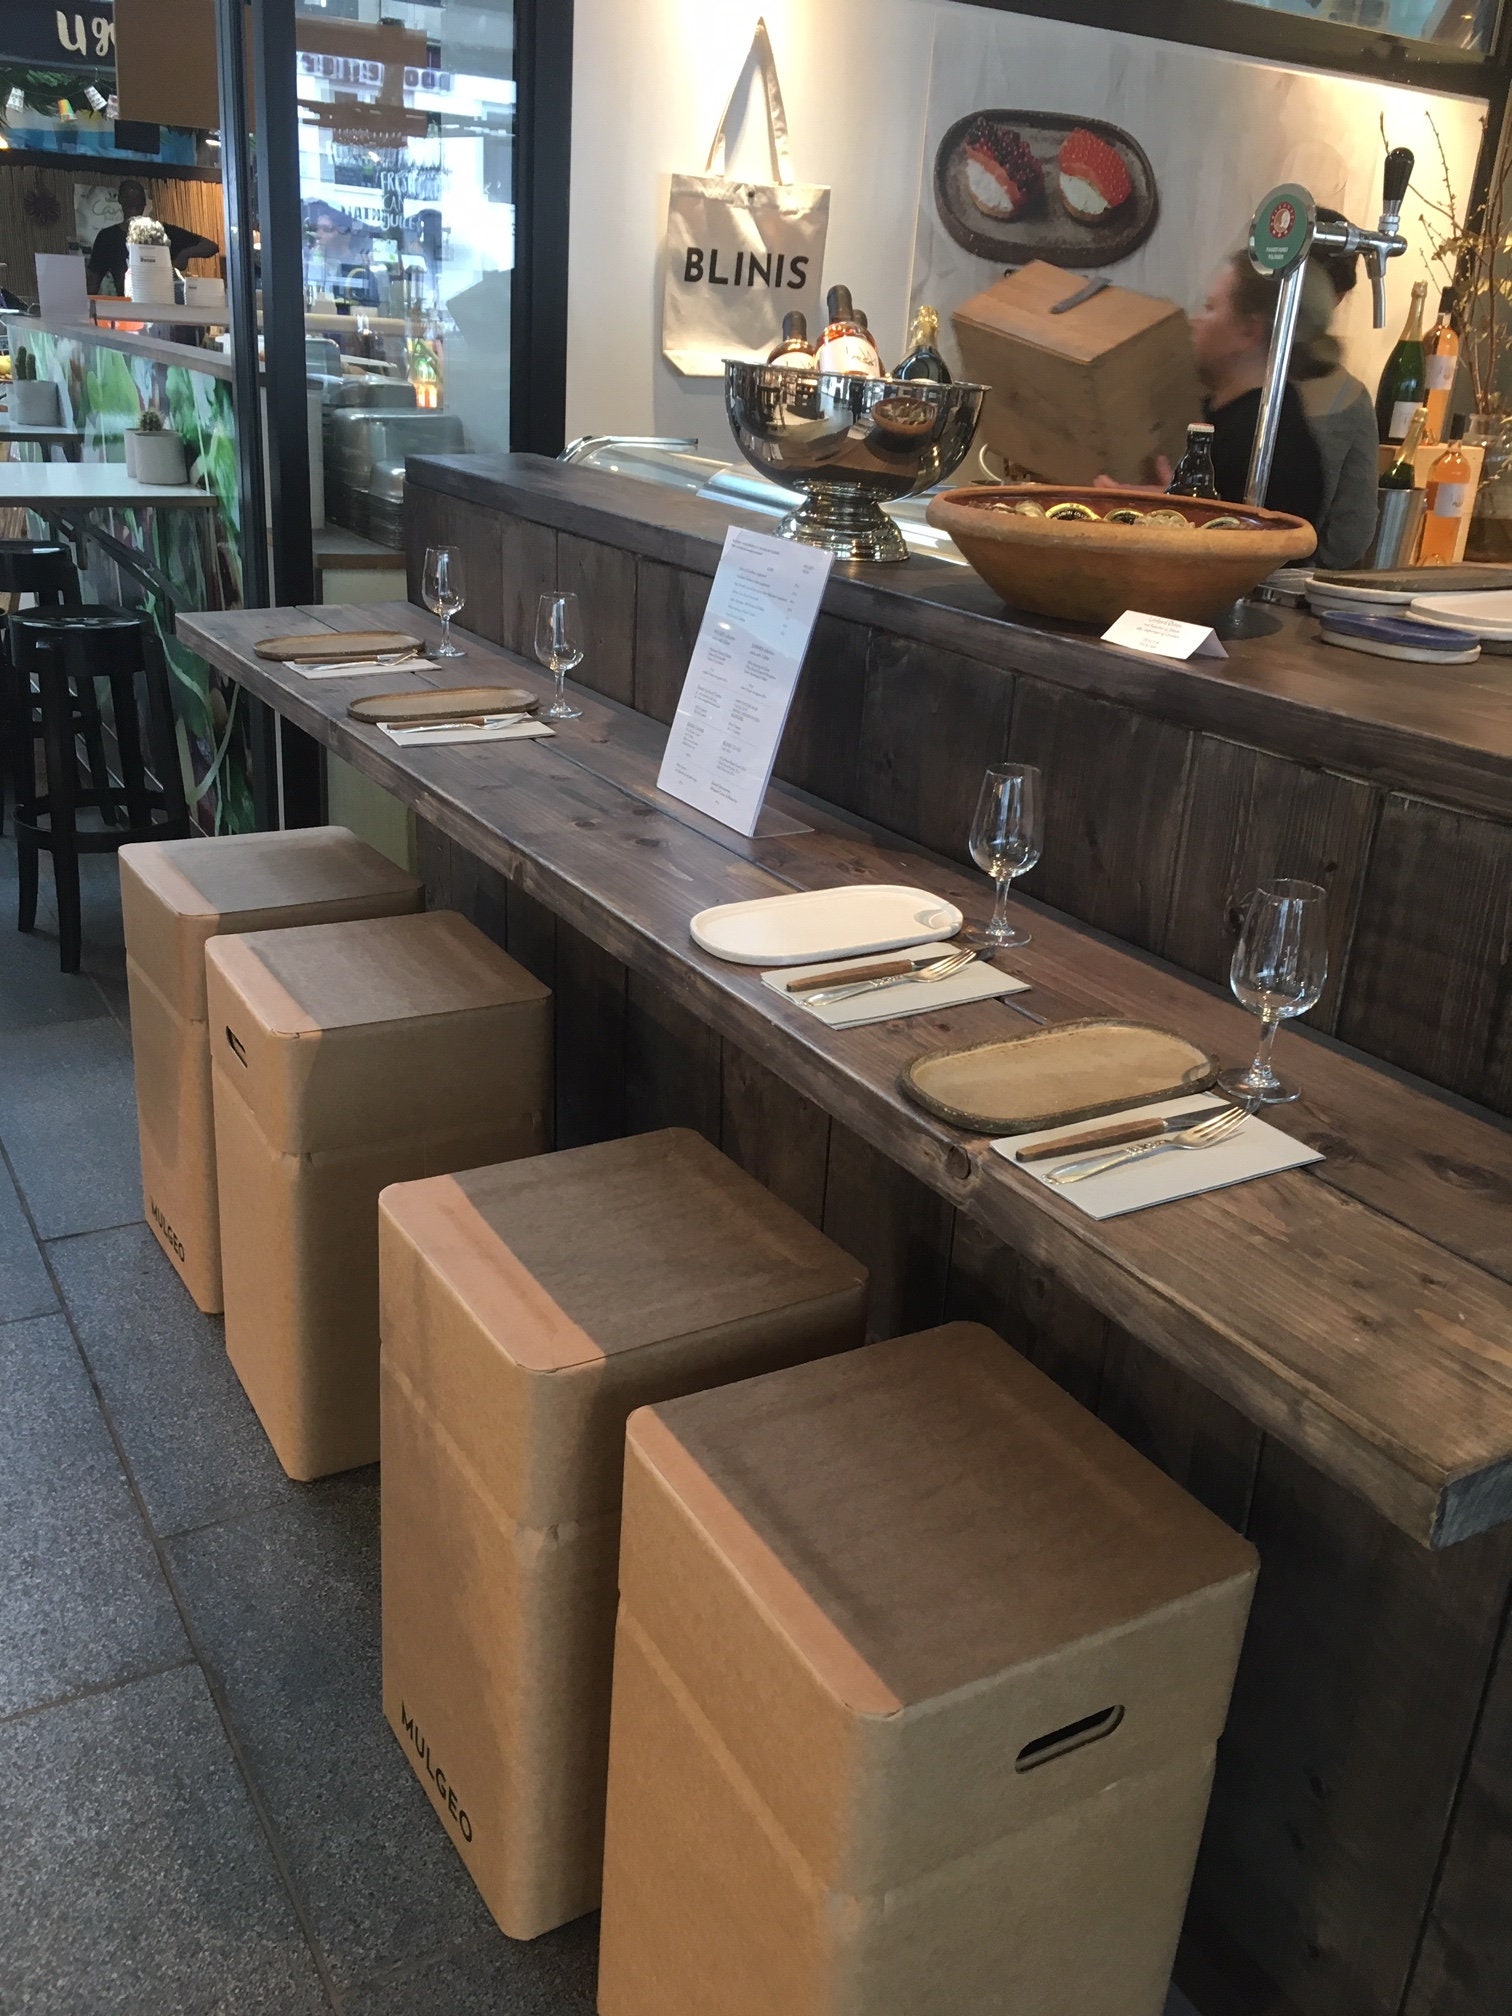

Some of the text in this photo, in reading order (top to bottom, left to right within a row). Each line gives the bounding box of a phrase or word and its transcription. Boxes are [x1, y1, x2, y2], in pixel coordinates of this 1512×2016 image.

[684, 246, 810, 289] BLINIS
[149, 1194, 186, 1263] MULGEO
[401, 1699, 474, 1844] MULGEO
